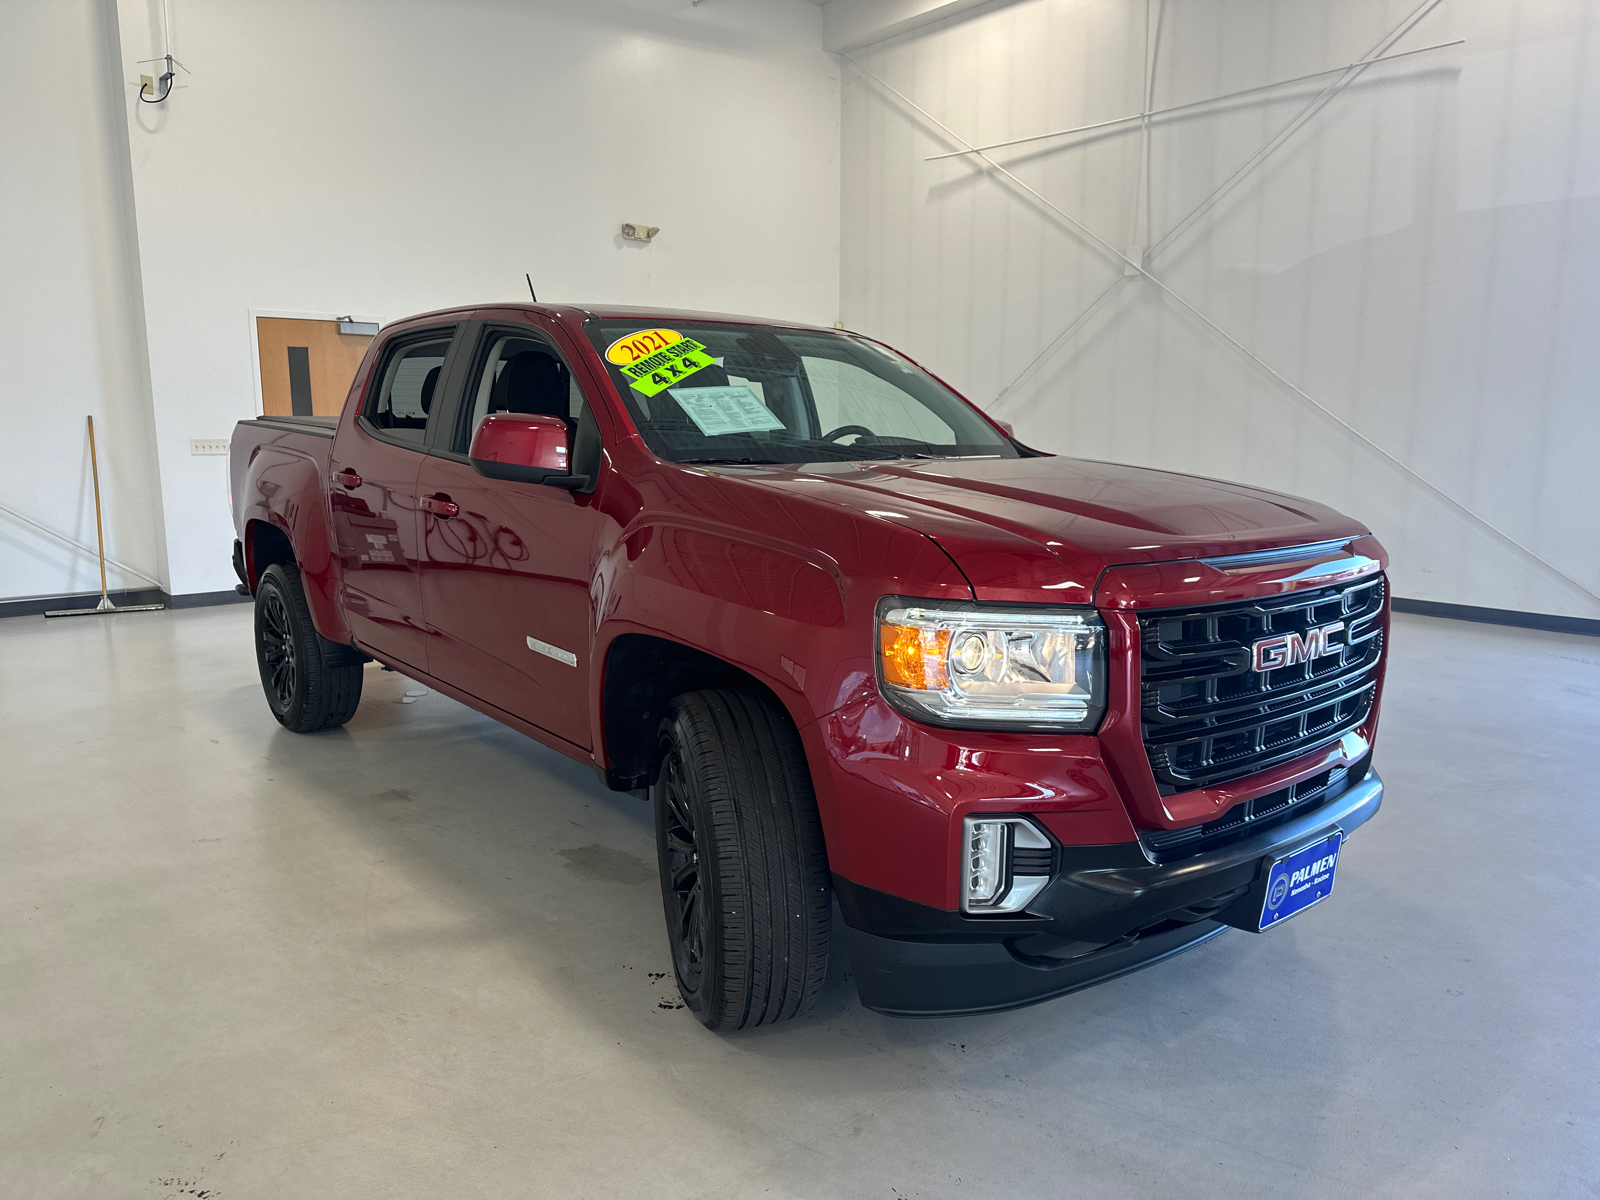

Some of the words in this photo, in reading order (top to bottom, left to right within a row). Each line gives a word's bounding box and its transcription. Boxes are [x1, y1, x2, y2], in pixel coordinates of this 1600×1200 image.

[620, 331, 672, 361] 2021
[627, 352, 675, 378] REMOTE
[666, 340, 701, 358] START
[651, 372, 672, 386] 4
[681, 357, 702, 370] 4
[1252, 621, 1344, 672] GMC
[1290, 852, 1337, 887] PALMEN
